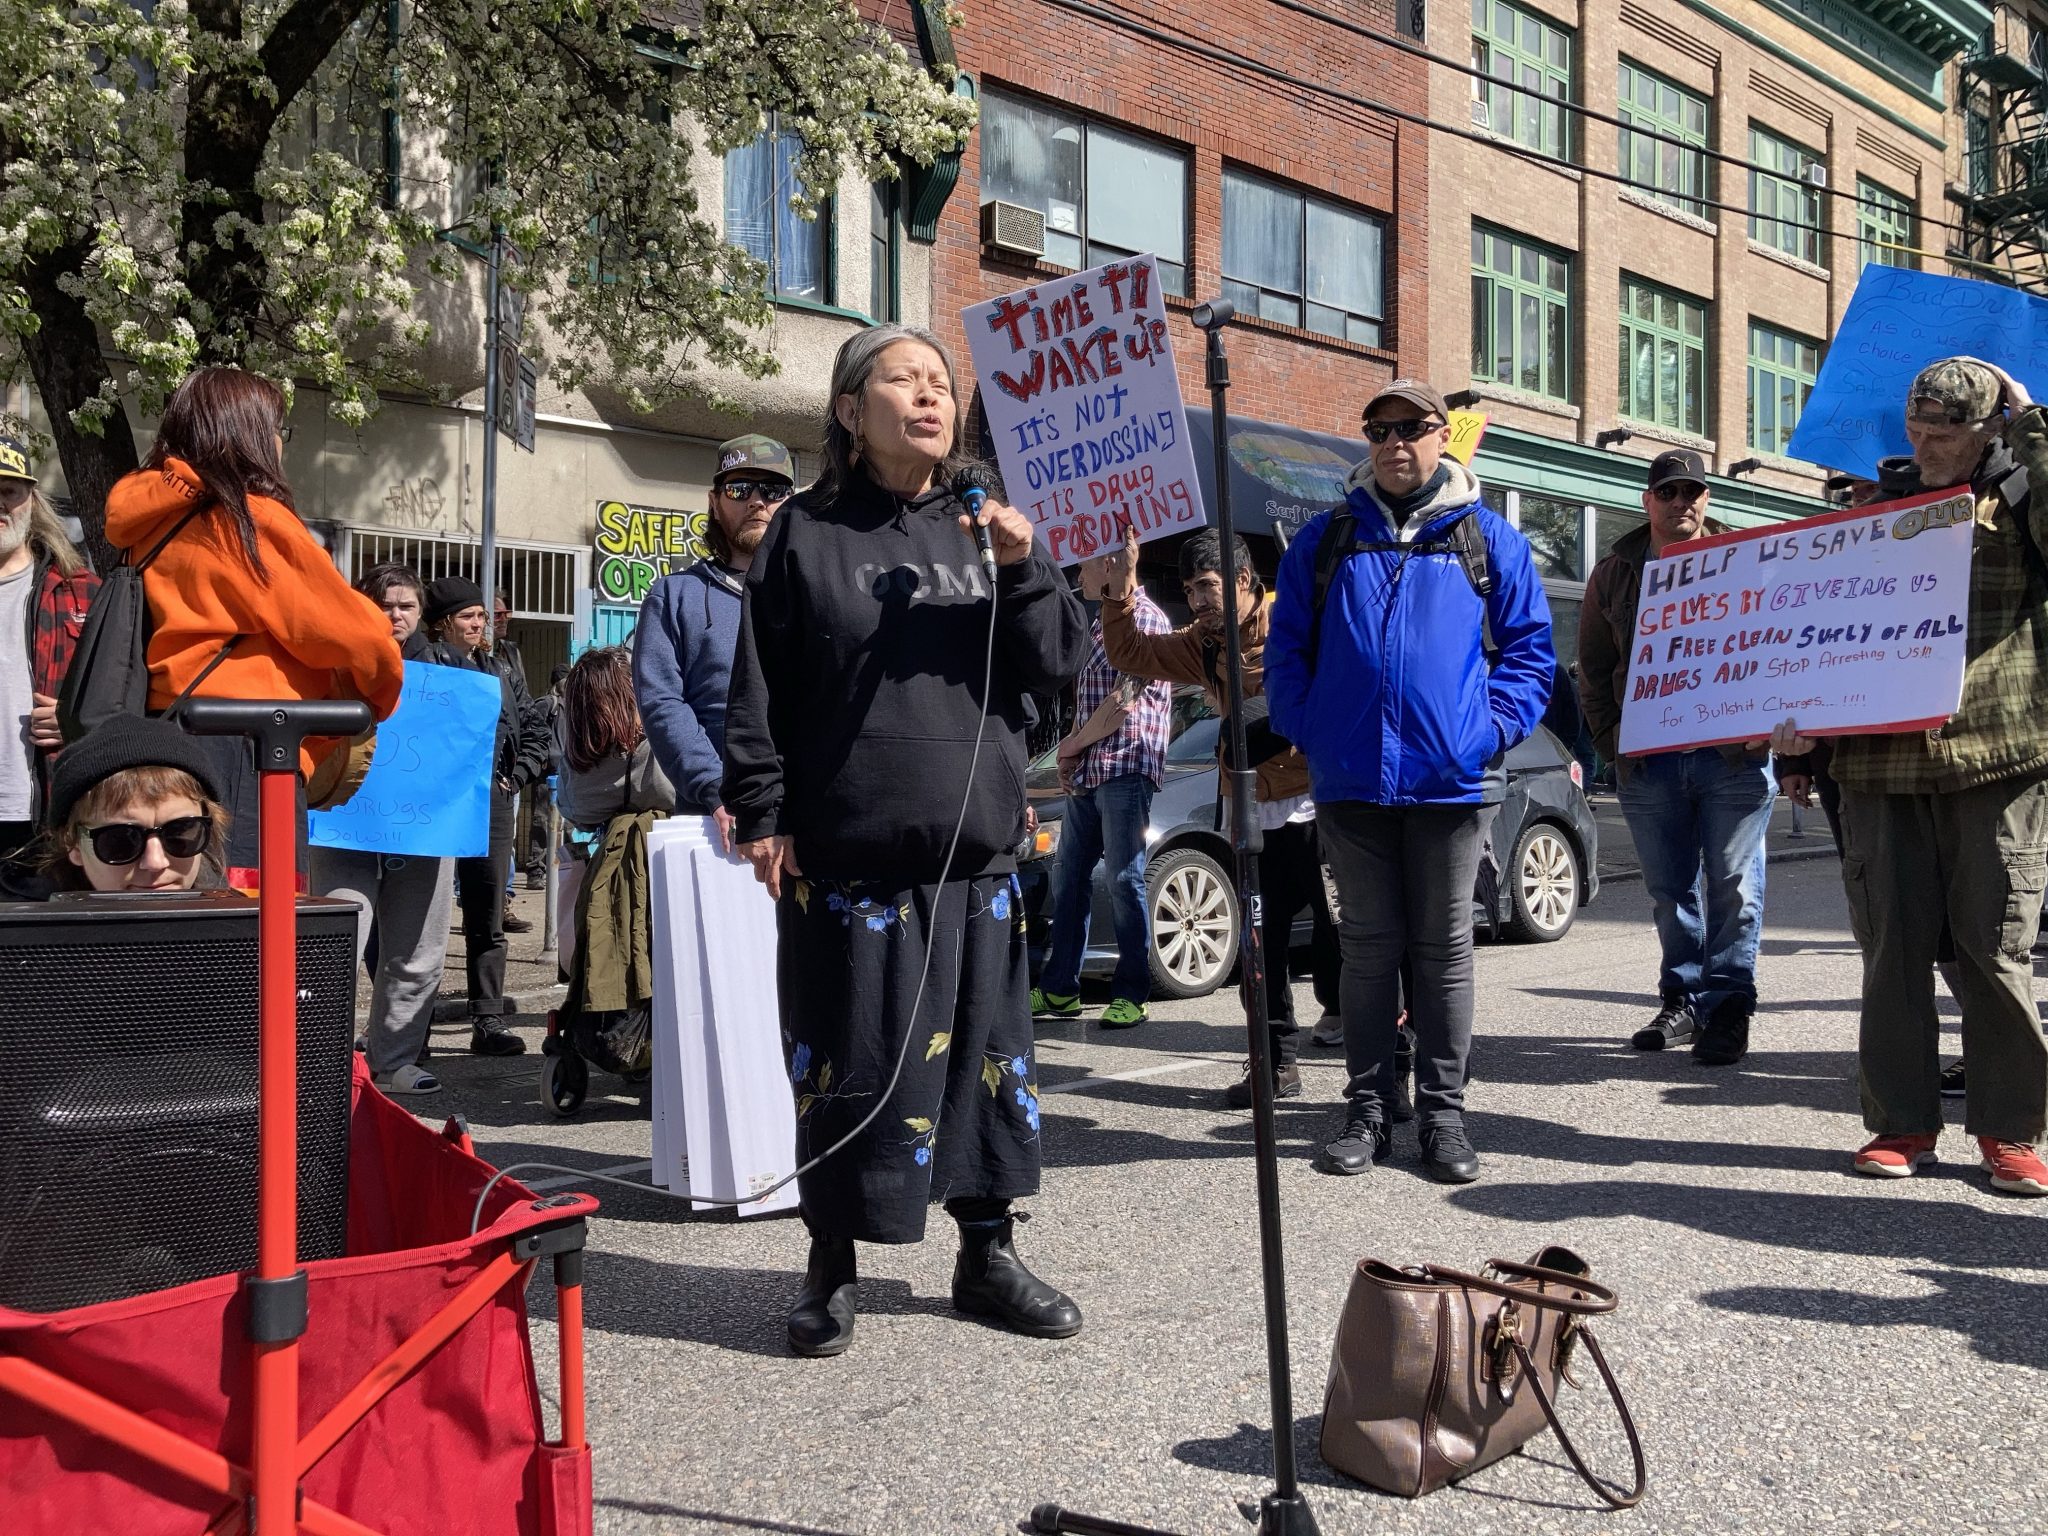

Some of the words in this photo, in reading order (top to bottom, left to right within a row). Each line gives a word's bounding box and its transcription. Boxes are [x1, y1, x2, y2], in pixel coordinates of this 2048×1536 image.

[1099, 261, 1151, 315] TO
[991, 326, 1123, 403] WAKE
[1075, 383, 1128, 432] NOT
[162, 471, 206, 501] ATTER
[597, 501, 687, 559] SAFE
[1647, 547, 1738, 597] HELP
[1758, 537, 1800, 564] US
[1809, 518, 1886, 560] SAVE
[1892, 494, 1974, 540] OUR
[599, 557, 657, 603] OR
[1739, 588, 1767, 615] BY
[1770, 575, 1897, 611] GIVEING
[1910, 573, 1938, 593] US
[1637, 644, 1653, 665] A
[1667, 635, 1716, 663] FREE
[1722, 626, 1792, 655] CLEAN
[1881, 624, 1908, 640] OF
[1913, 614, 1964, 639] ALL
[1631, 668, 1702, 702] DRUGS
[1713, 660, 1758, 685] AND
[1763, 656, 1810, 679] Stop
[1818, 649, 1886, 669] Arresting
[1658, 706, 1685, 728] for
[1693, 698, 1755, 724] Bullshit
